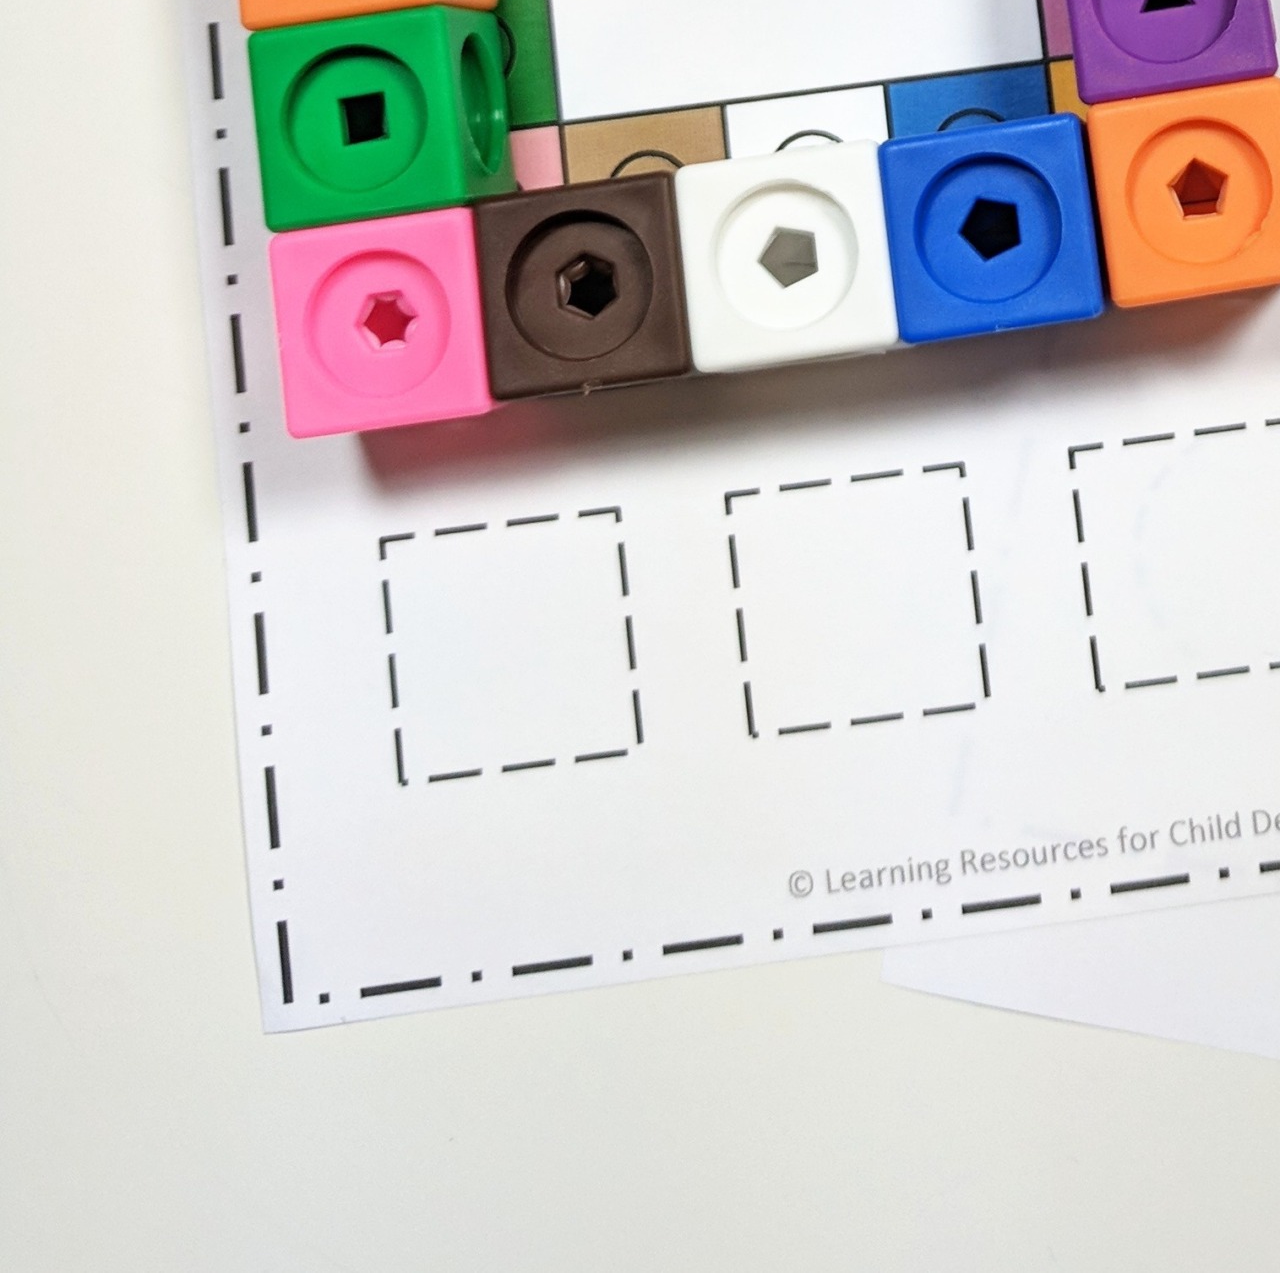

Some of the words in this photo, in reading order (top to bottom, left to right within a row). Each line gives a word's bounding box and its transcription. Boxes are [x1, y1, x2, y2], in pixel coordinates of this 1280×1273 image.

[825, 856, 952, 894] Learning
[960, 833, 1109, 874] Resources
[1117, 825, 1159, 853] for
[1169, 815, 1242, 847] Child
